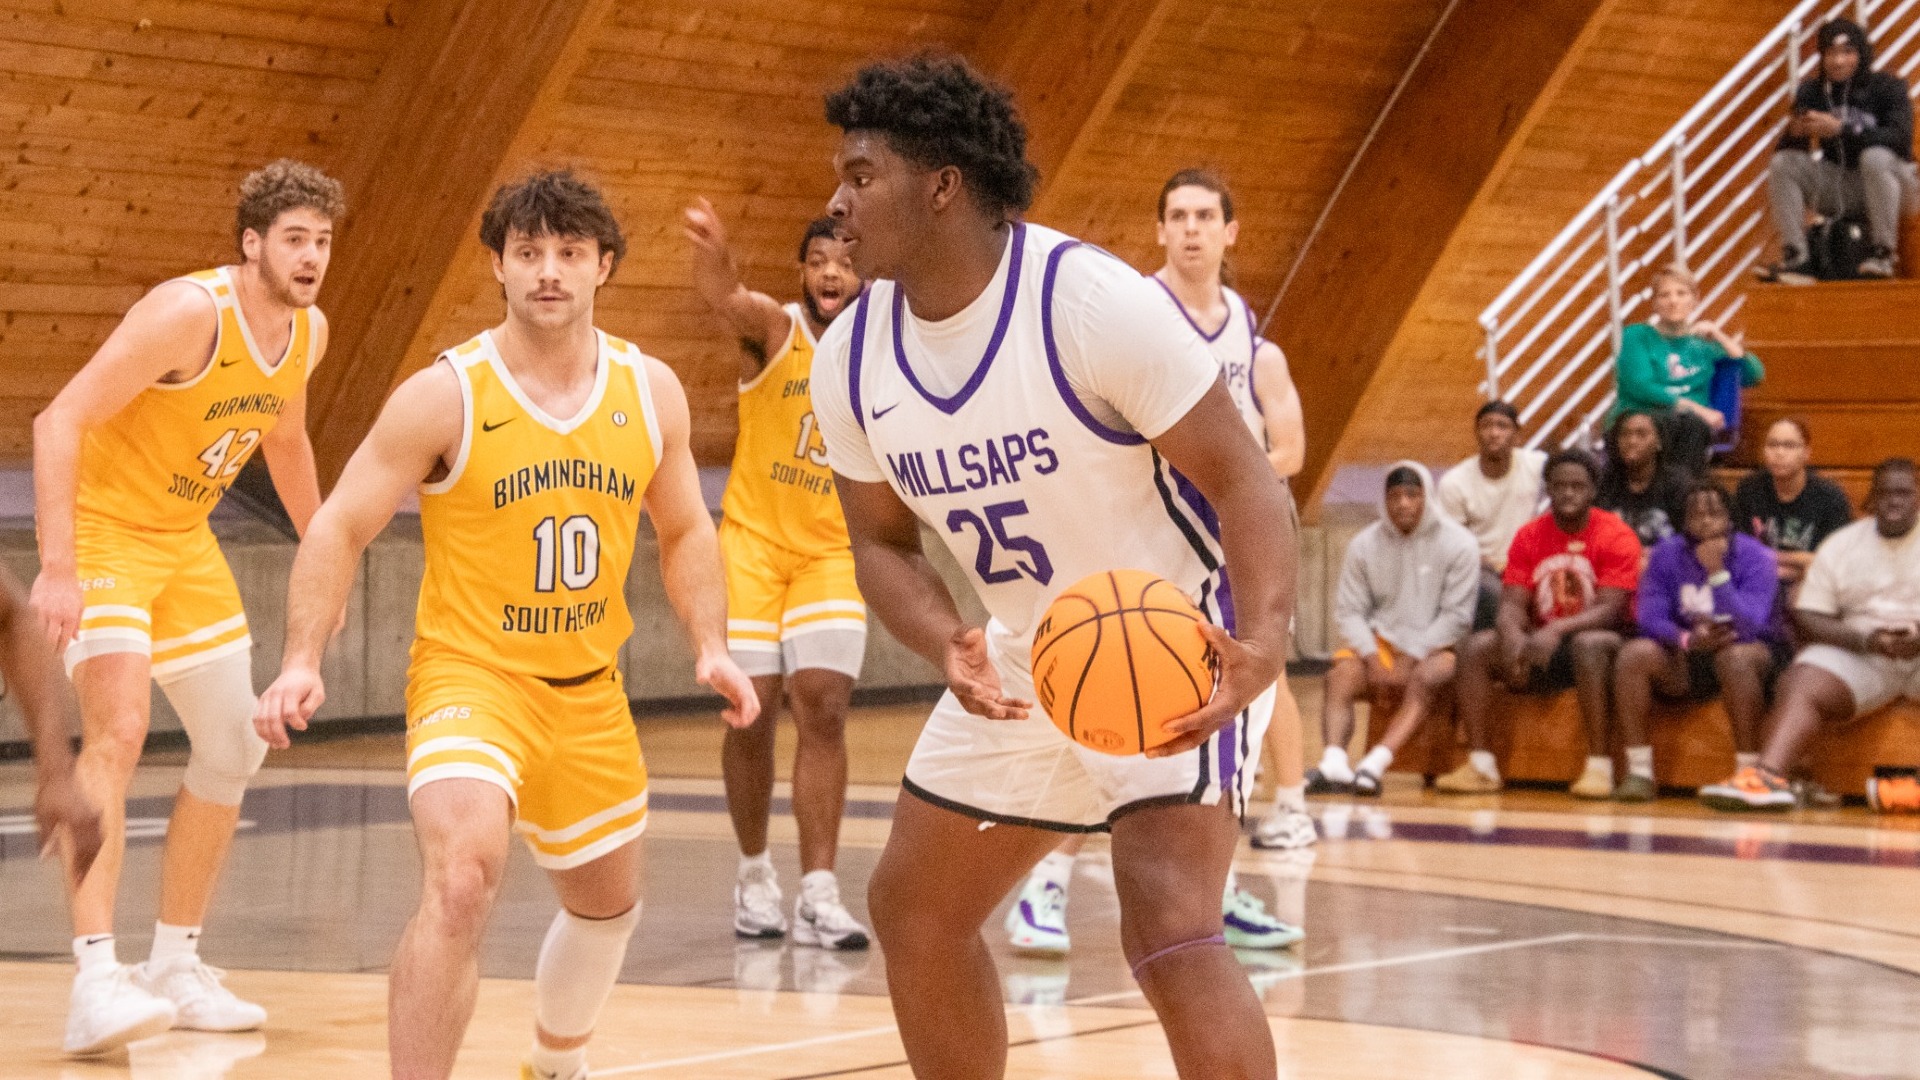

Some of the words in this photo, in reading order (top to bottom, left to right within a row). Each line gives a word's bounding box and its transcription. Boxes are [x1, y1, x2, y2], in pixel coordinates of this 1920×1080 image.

[197, 428, 262, 479] 42
[770, 461, 832, 494] SOUTHER
[886, 427, 1059, 497] MILLSAPS
[493, 459, 635, 510] BIRMINGHAM
[533, 514, 600, 592] 10
[946, 499, 1054, 586] 25
